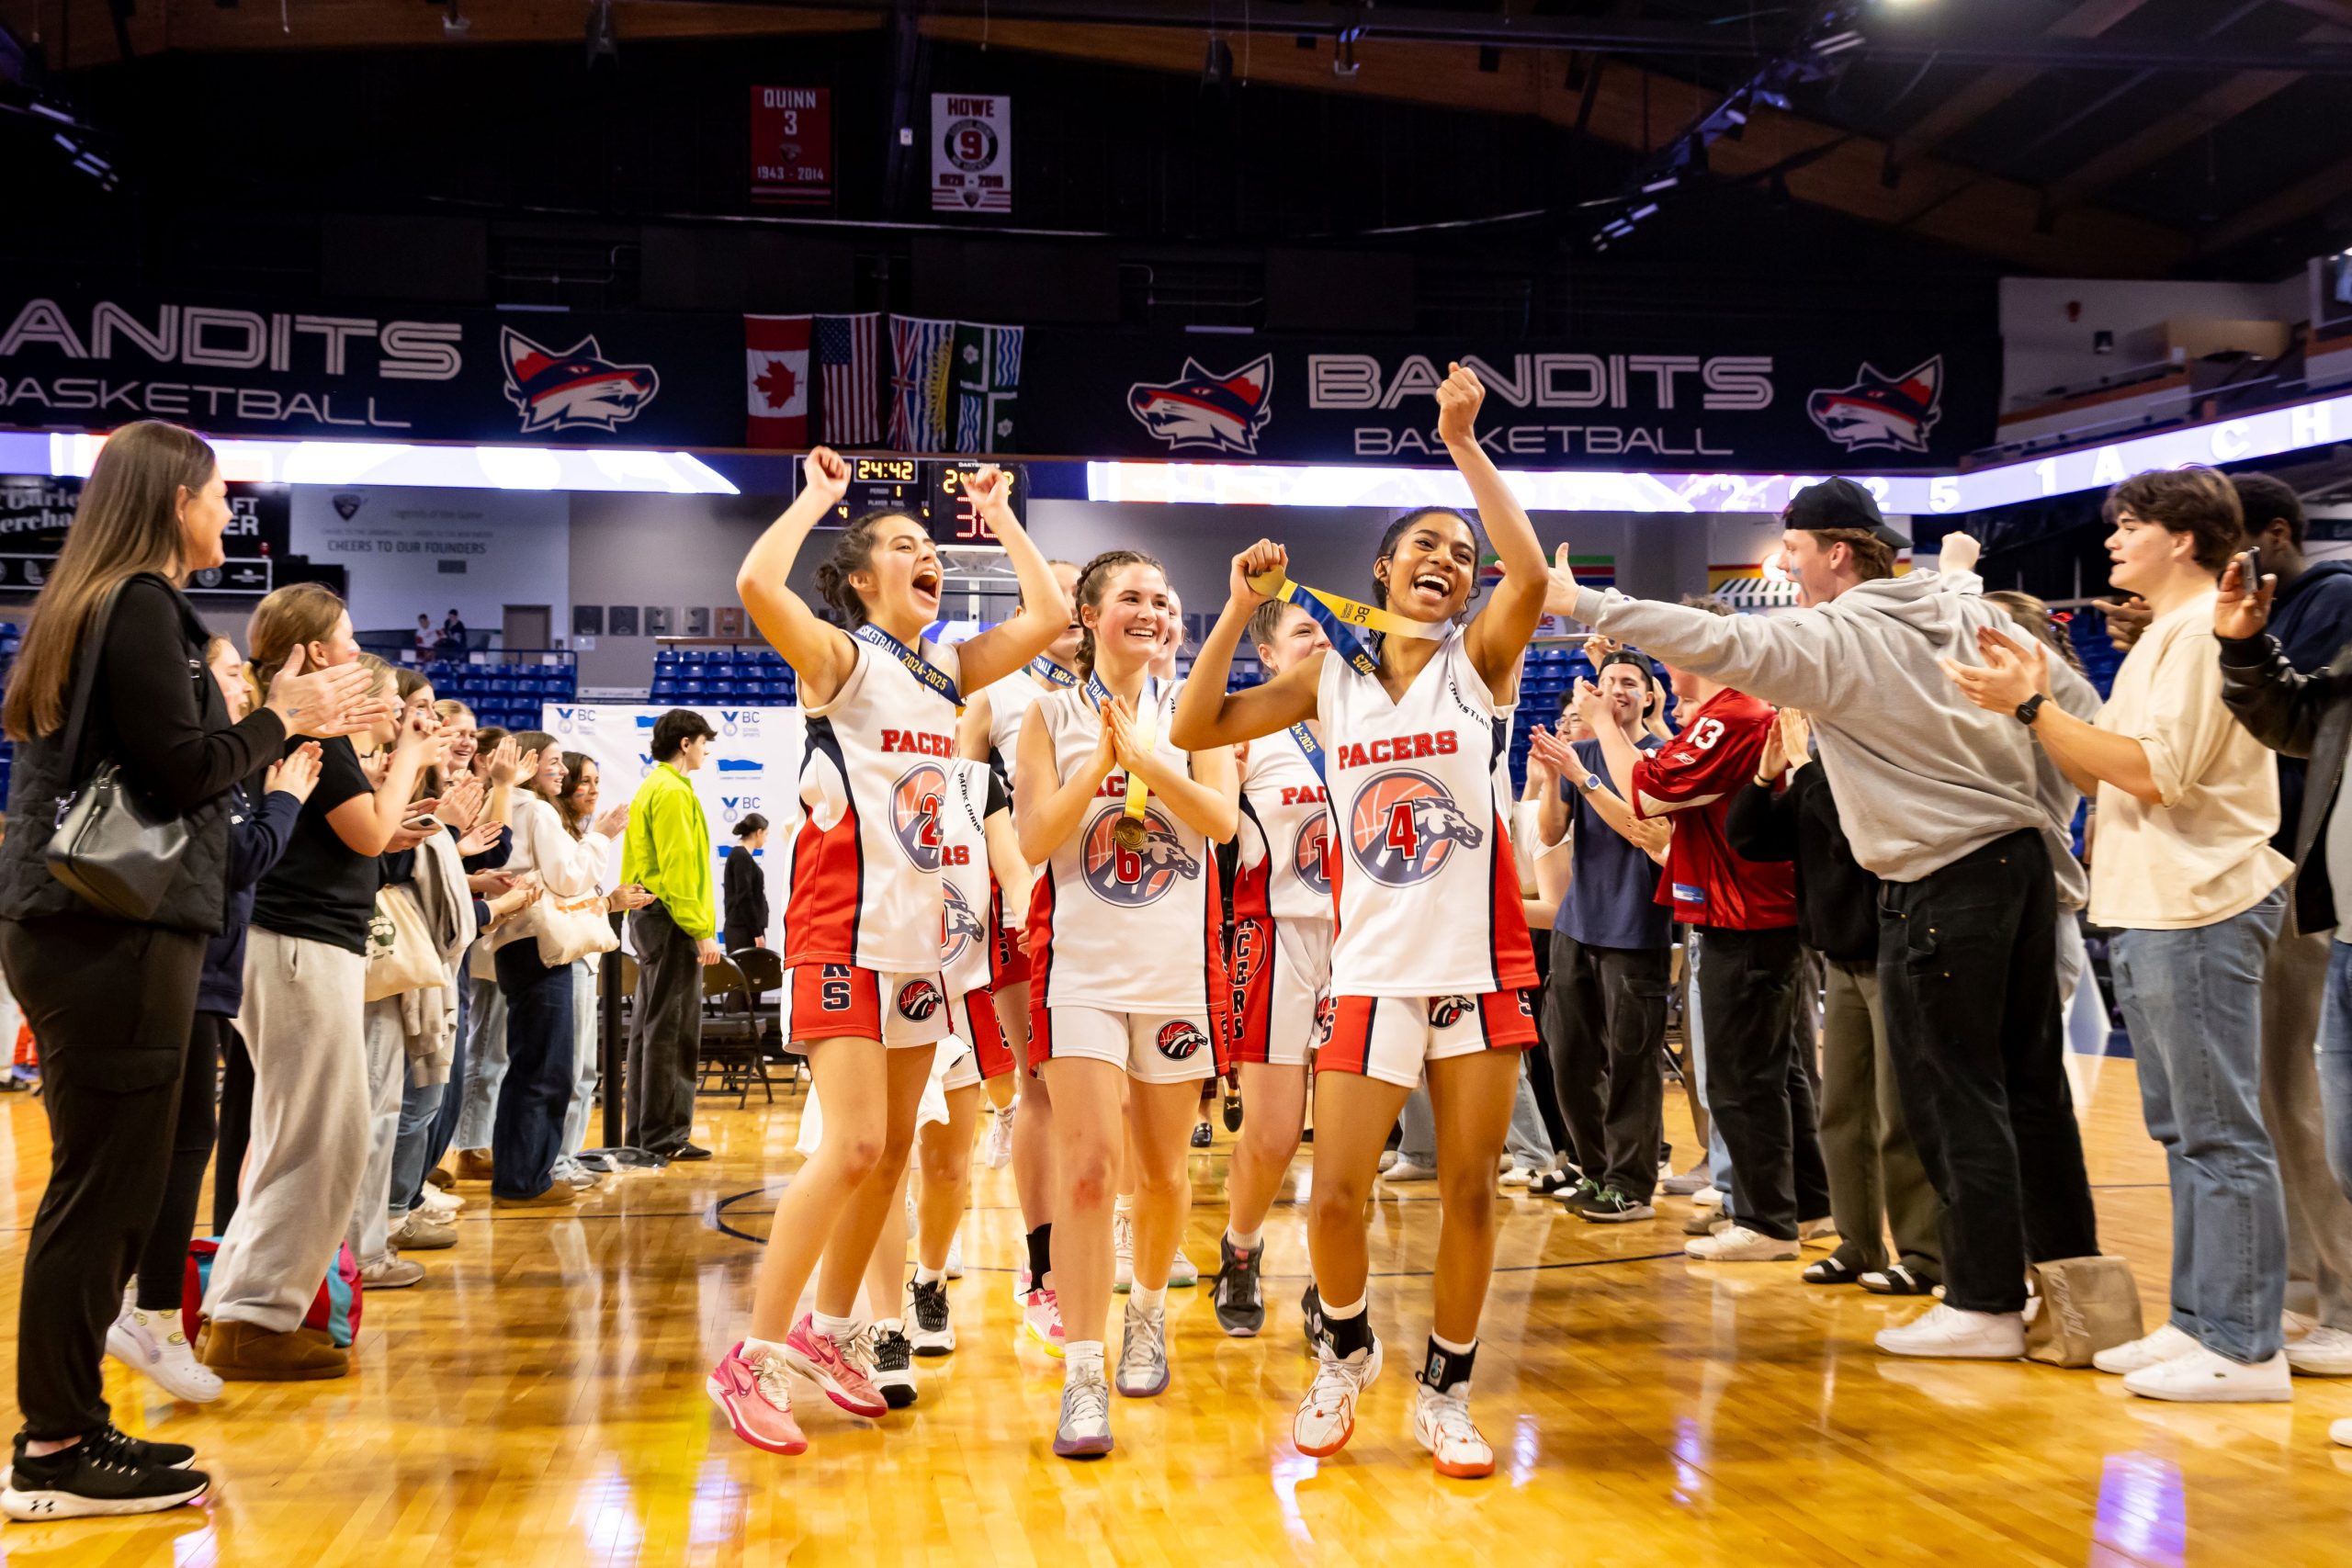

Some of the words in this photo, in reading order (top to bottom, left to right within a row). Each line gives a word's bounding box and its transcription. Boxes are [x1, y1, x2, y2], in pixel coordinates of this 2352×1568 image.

[763, 89, 816, 108] QUINN
[947, 97, 994, 118] HOWE
[785, 110, 797, 135] 3
[960, 130, 982, 160] 9
[757, 166, 784, 179] 1943
[798, 167, 823, 181] 2014
[1308, 354, 1774, 409] BANDITS
[0, 377, 412, 428] ASKETBALL
[858, 460, 913, 480] 24:42
[0, 510, 74, 534] ercha
[838, 506, 848, 519] 4
[224, 515, 259, 536] ER
[327, 540, 372, 552] CHEERS
[377, 540, 392, 552] TO
[396, 541, 422, 553] OUR
[424, 541, 487, 554] FOUNDERS
[1354, 605, 1370, 624] BC
[858, 625, 901, 657] SKETBALL
[901, 653, 947, 691] 2024-2025
[1051, 668, 1073, 684] 2024-
[577, 709, 597, 722] BC
[742, 711, 761, 723] BC
[881, 729, 955, 760] PACER
[1291, 722, 1317, 753] 24-2025
[1686, 716, 1724, 750] 13
[1338, 730, 1459, 771] PACERS
[742, 797, 761, 809] BC
[1280, 785, 1328, 806] PAC
[919, 793, 941, 849] 2
[965, 804, 985, 836] CHRIST
[1385, 801, 1421, 862] 4
[1113, 841, 1143, 885] 6
